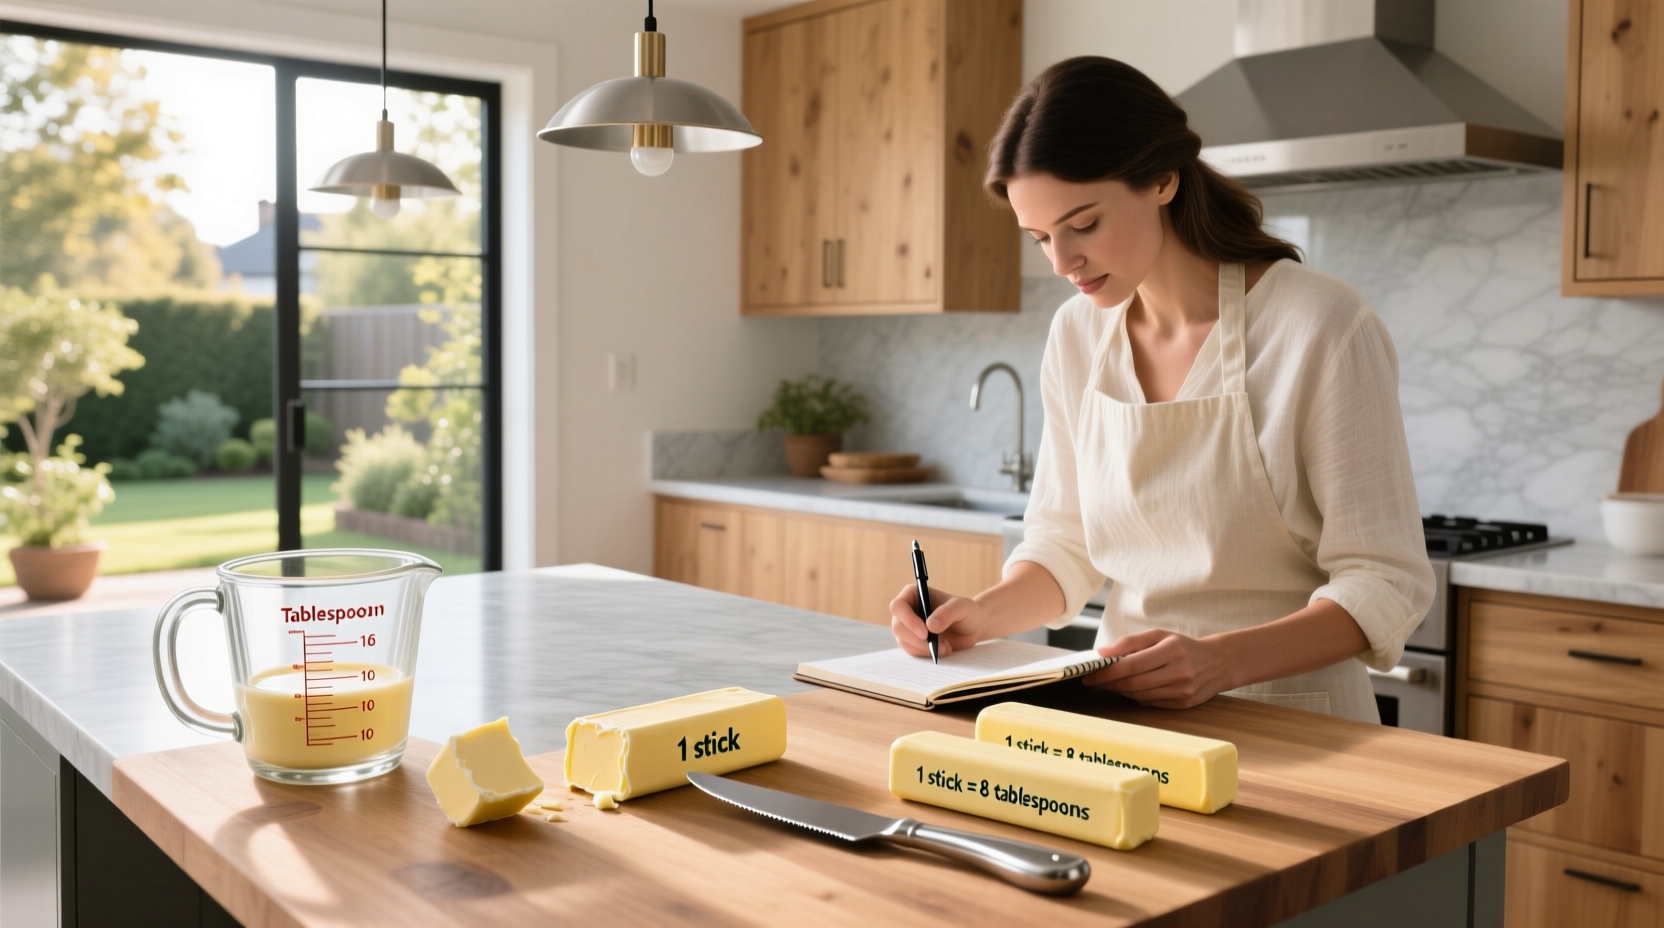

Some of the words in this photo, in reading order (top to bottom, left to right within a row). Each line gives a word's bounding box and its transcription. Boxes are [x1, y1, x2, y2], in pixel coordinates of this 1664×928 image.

[360, 634, 376, 648] 16
[361, 670, 376, 682] 10
[361, 700, 375, 712] 10
[361, 729, 374, 741] 10
[677, 735, 687, 762] 1
[693, 726, 741, 759] stick
[1005, 734, 1012, 747] 1
[1053, 748, 1063, 757] =
[916, 765, 923, 784] 1
[928, 769, 963, 793] stick
[967, 781, 977, 792] =
[979, 779, 990, 798] 8
[993, 784, 1091, 821] tablespoons
